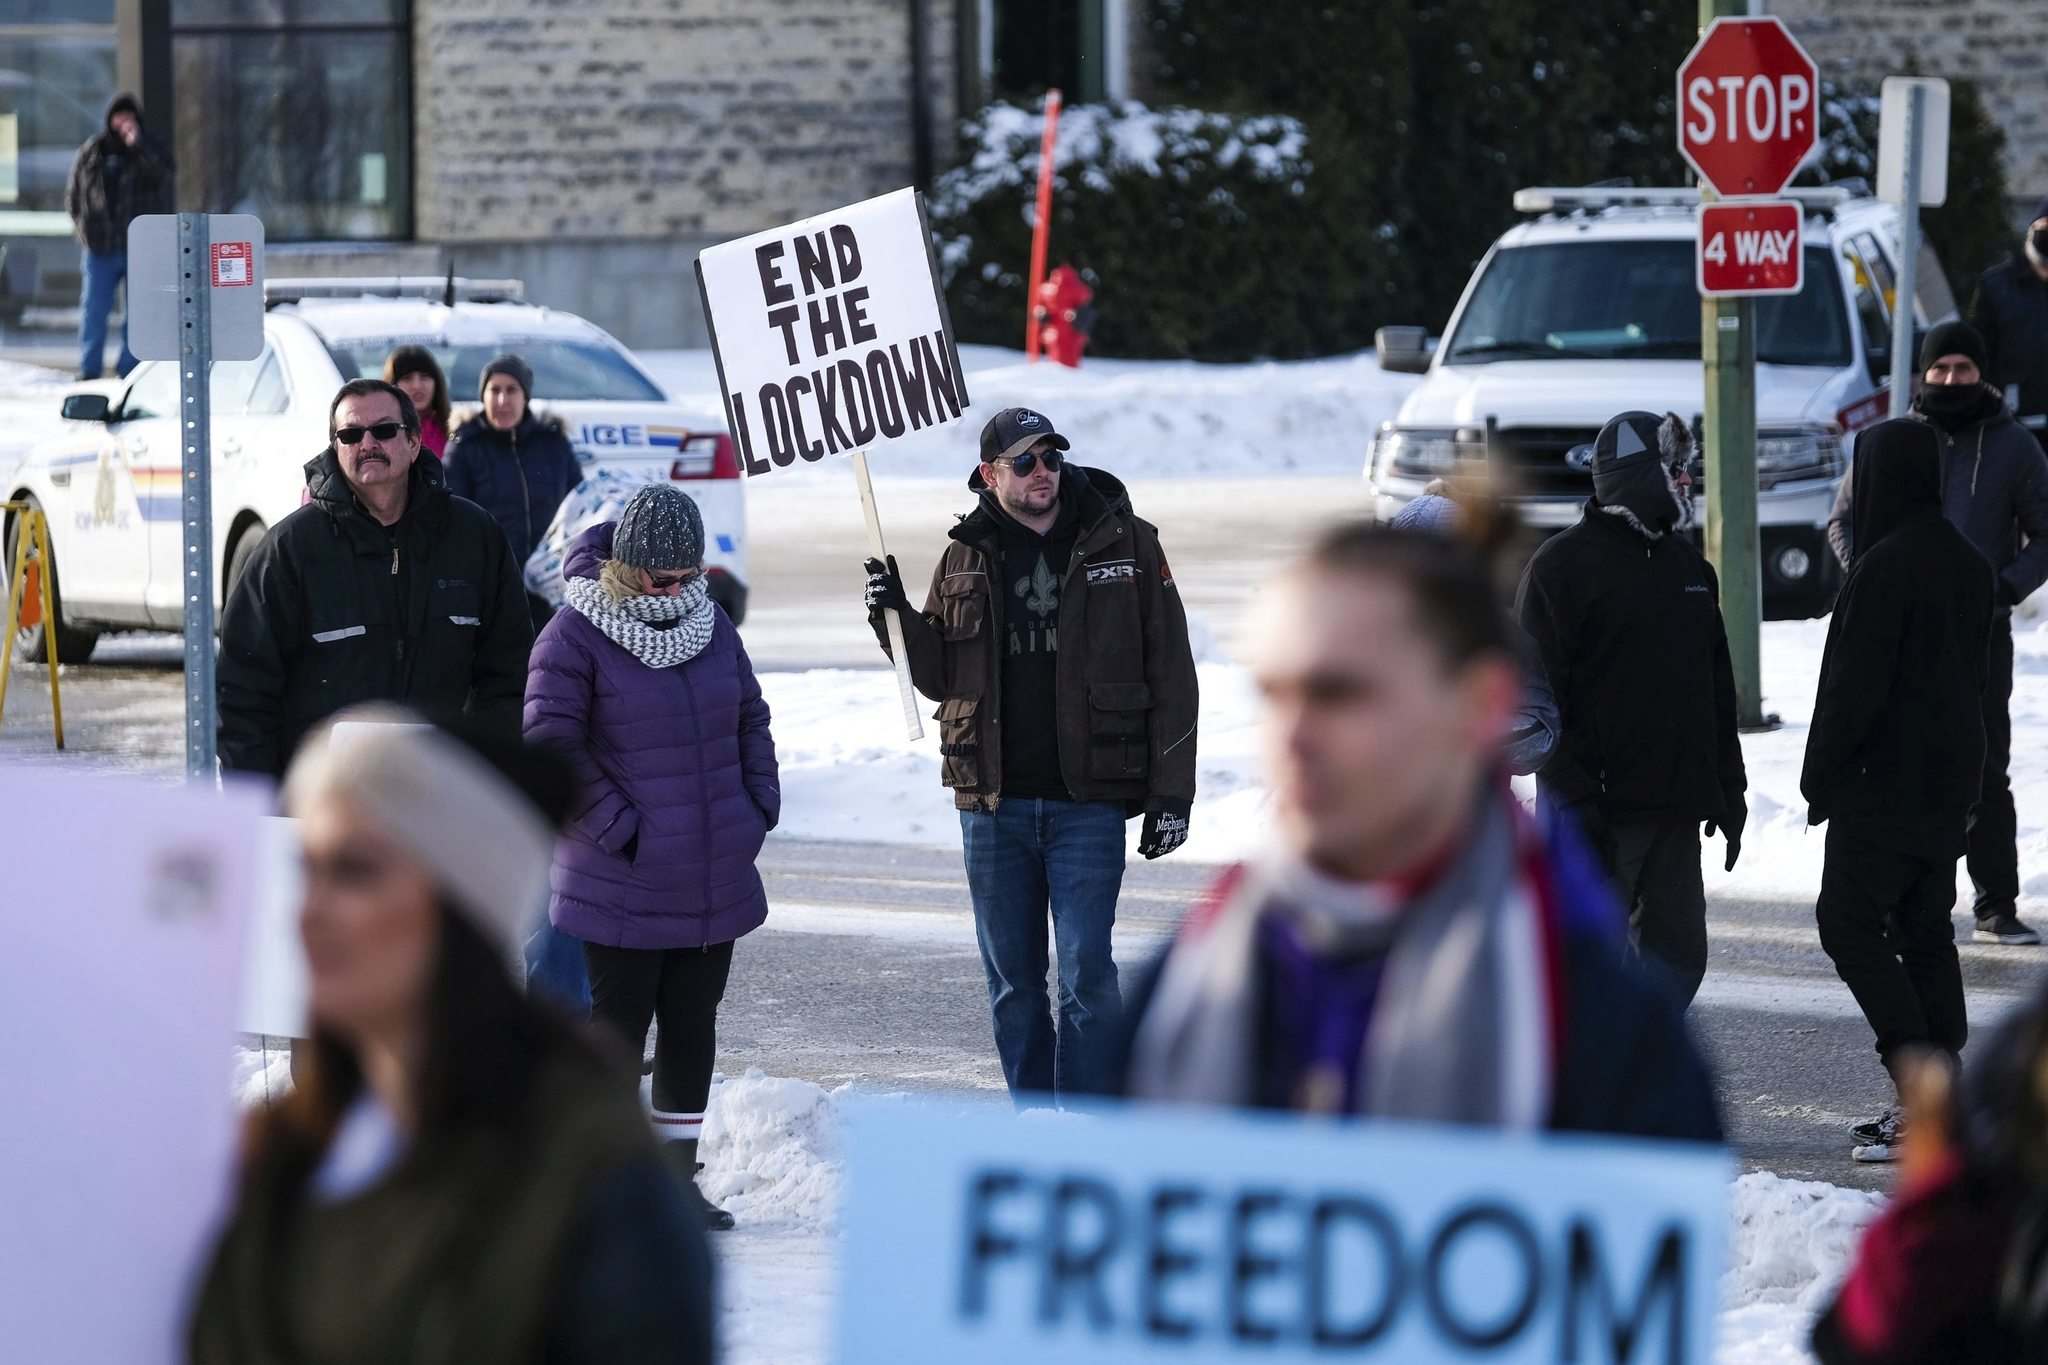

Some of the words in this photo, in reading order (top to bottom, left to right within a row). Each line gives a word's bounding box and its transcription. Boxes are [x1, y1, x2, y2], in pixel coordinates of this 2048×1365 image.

[1687, 74, 1810, 144] STOP
[755, 224, 862, 306] END
[1704, 231, 1727, 266] 4
[1734, 229, 1796, 266] WAY
[768, 286, 877, 366] THE
[732, 330, 962, 477] LOCKDOWN
[1087, 565, 1135, 581] FXR
[960, 1167, 1693, 1365] FREEDOM
